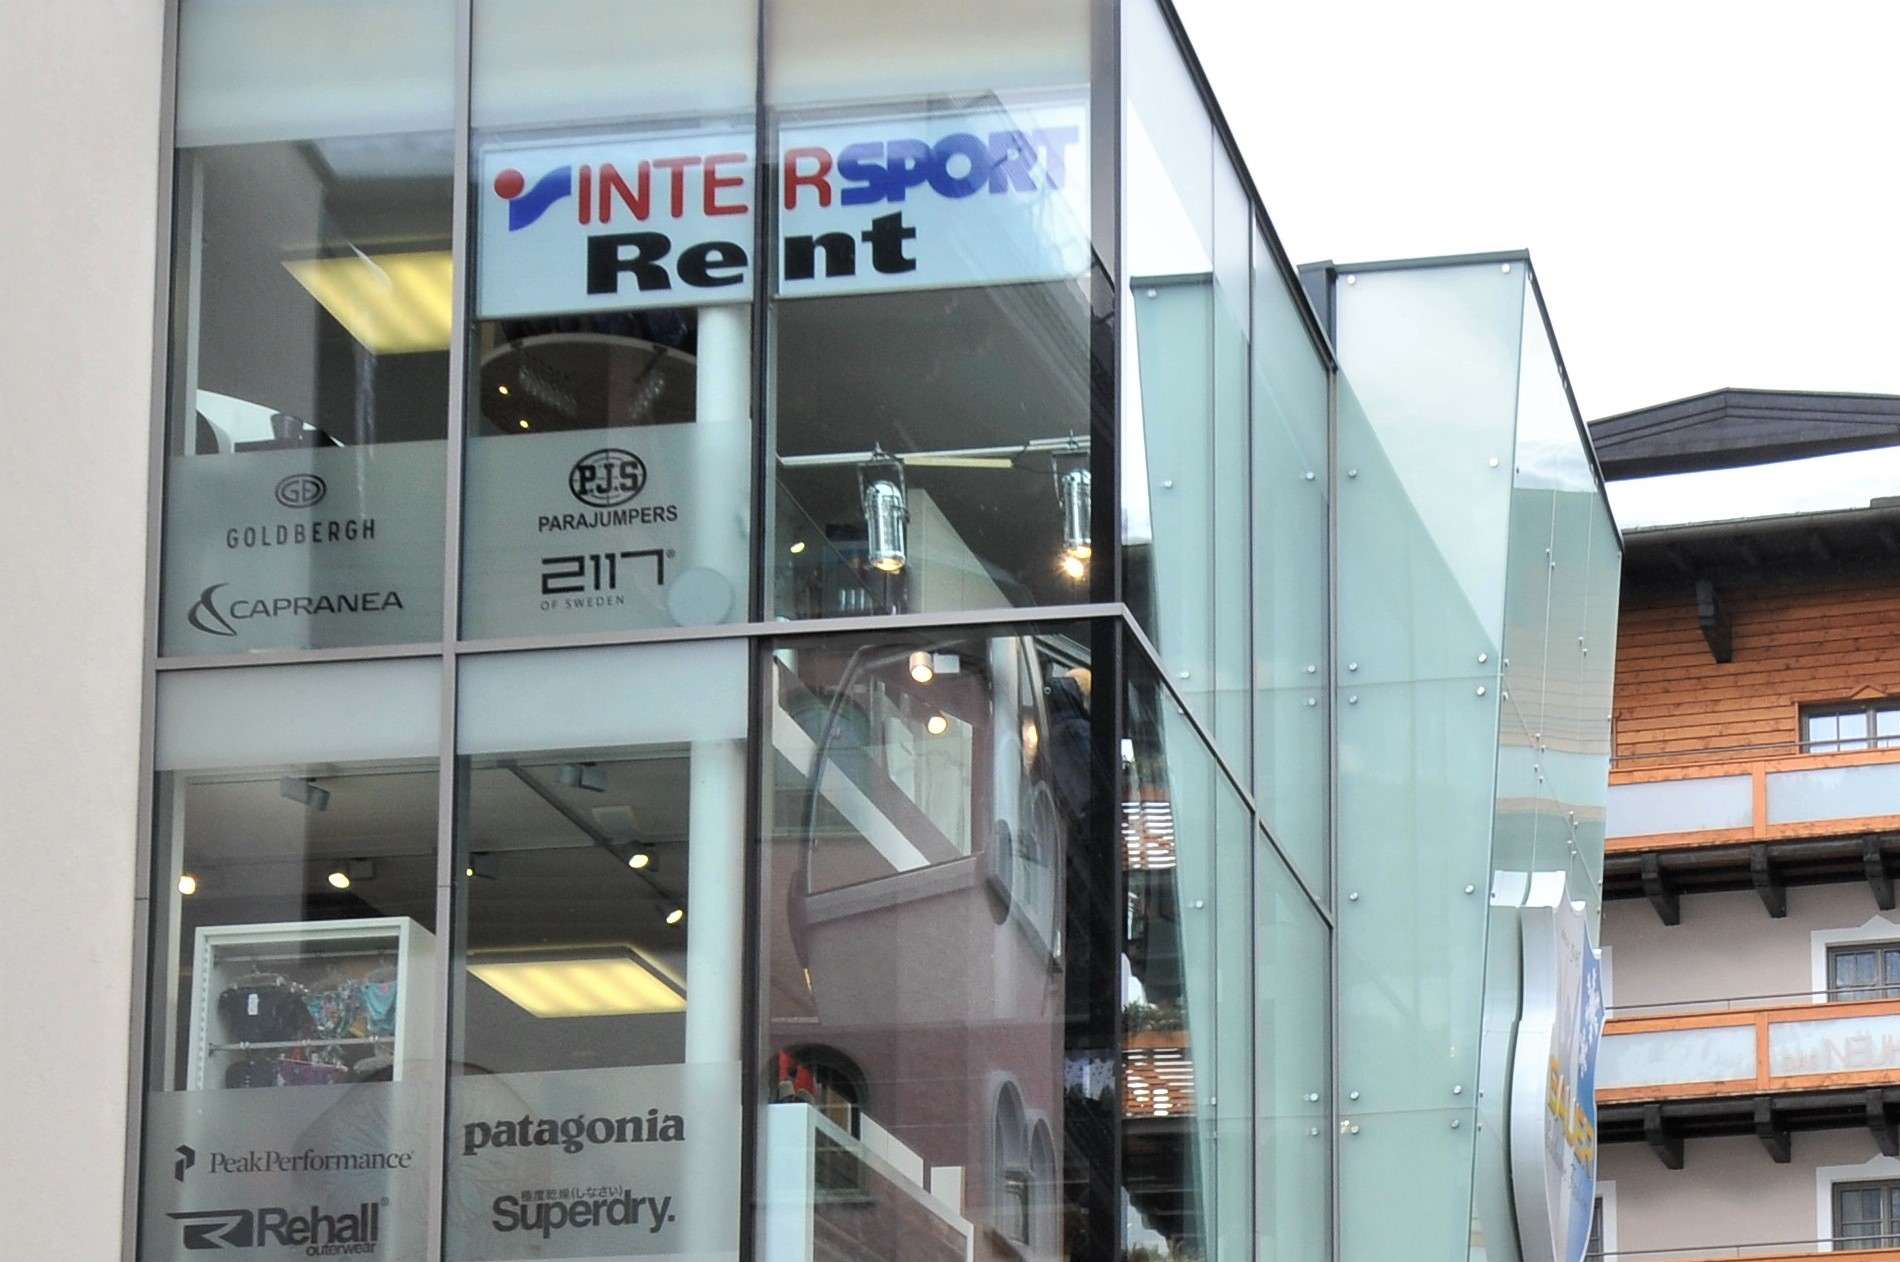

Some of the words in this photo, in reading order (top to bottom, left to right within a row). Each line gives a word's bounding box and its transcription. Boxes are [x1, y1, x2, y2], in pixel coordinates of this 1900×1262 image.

[579, 125, 1079, 225] INTERSPORT
[586, 211, 917, 295] Rent
[226, 518, 376, 549] GOLDBERGH
[538, 504, 679, 533] PARAJUMPERS
[230, 591, 405, 620] CAPRANEA
[540, 600, 557, 611] OF
[565, 594, 625, 609] SWEDEN
[462, 1108, 686, 1157] patagonia
[256, 1202, 380, 1248] Rehall
[305, 1242, 377, 1258] outerwear
